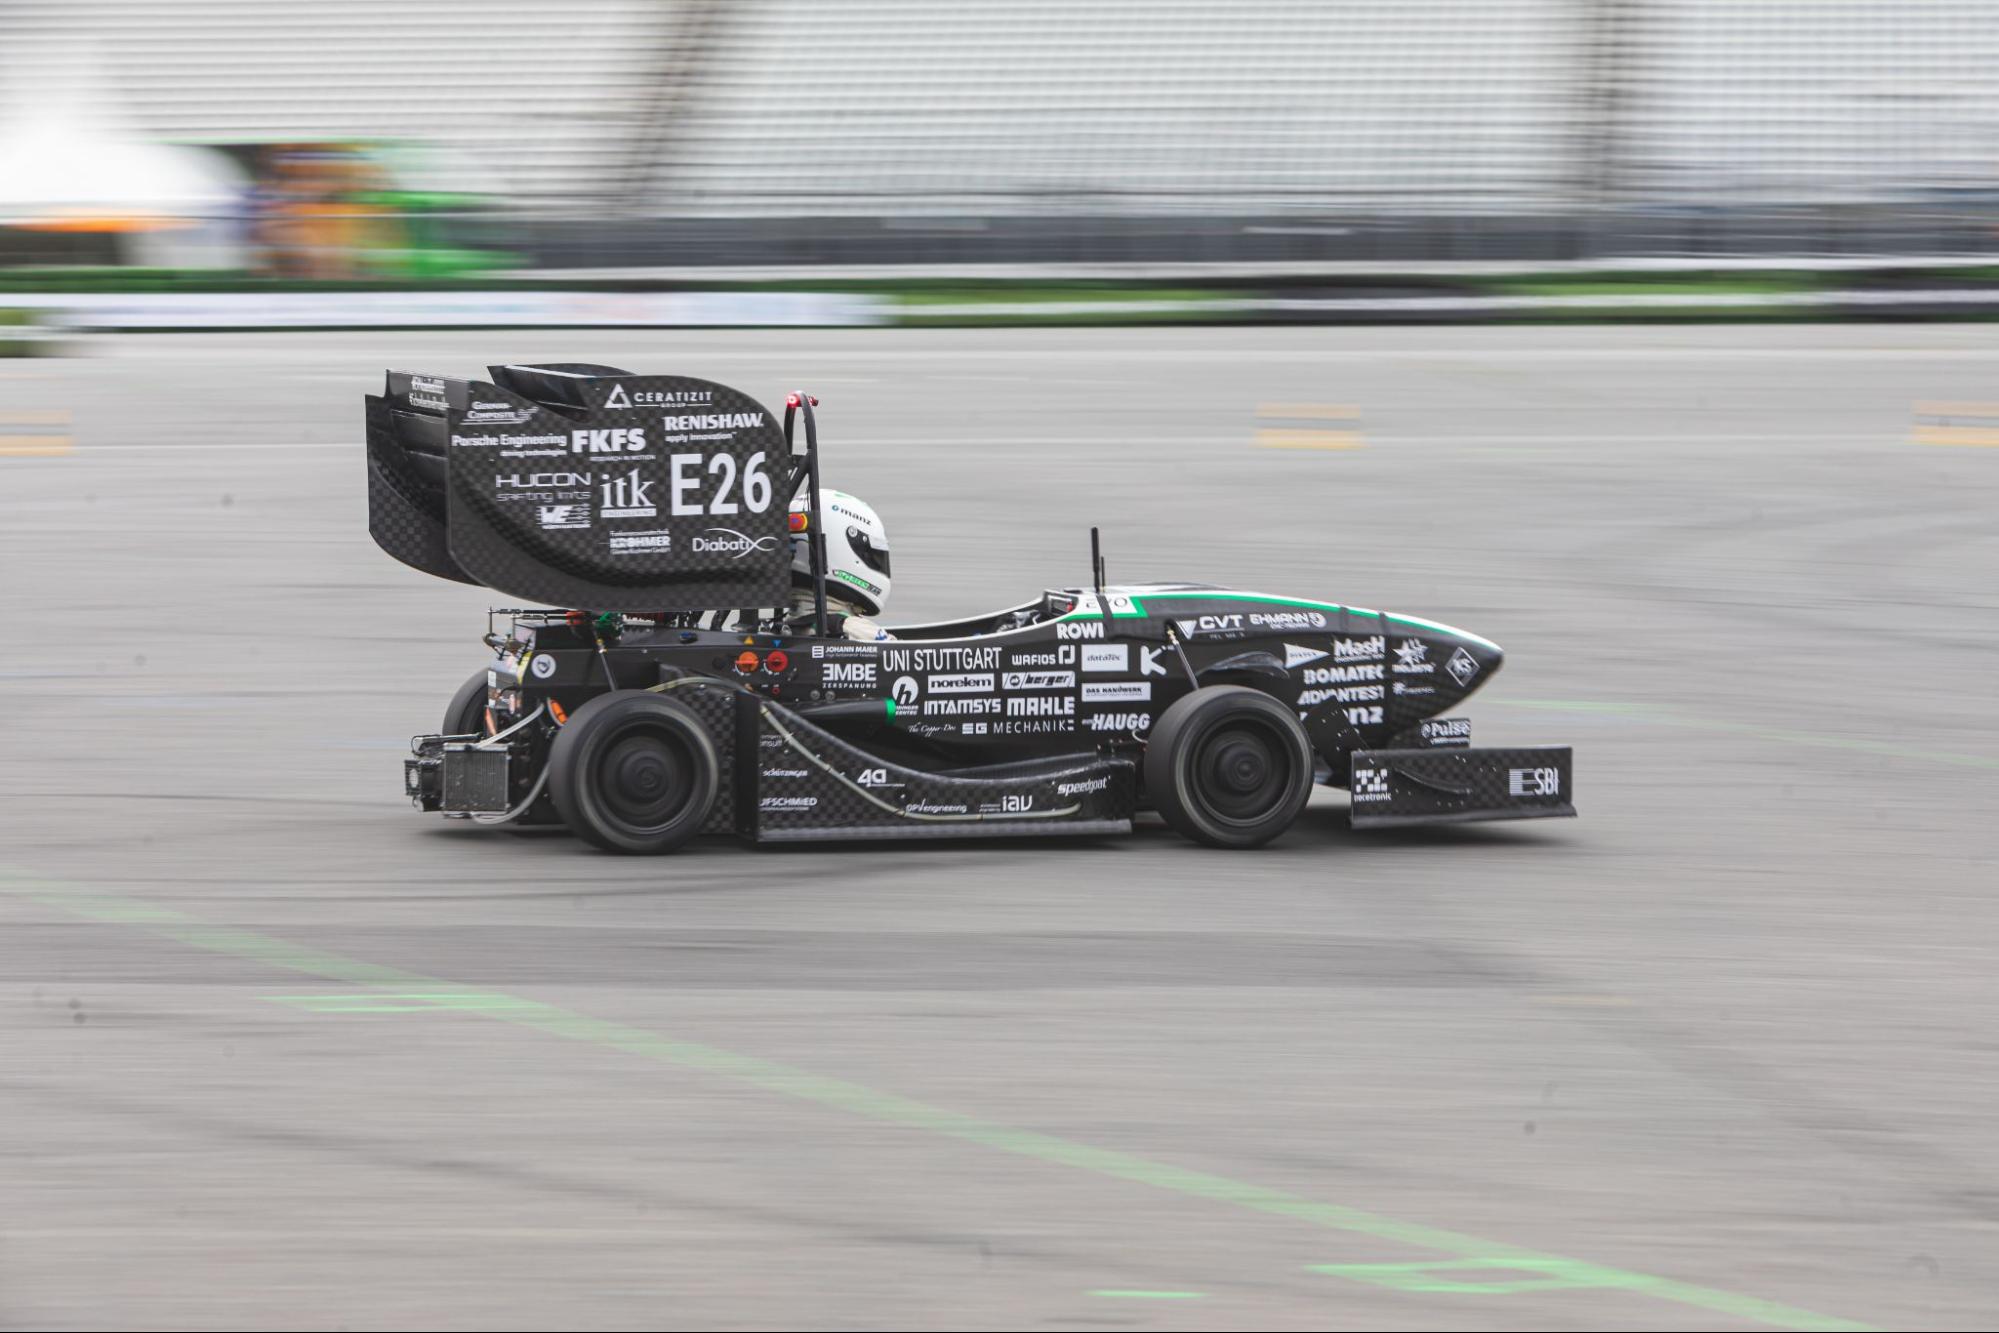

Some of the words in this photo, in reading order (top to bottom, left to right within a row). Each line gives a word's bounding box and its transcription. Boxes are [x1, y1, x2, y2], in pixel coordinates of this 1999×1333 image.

[633, 391, 713, 403] CERATIZIT
[663, 412, 763, 431] RENISHAW
[451, 434, 499, 447] Porsche
[500, 432, 568, 448] Engineering
[571, 428, 646, 453] FKFS
[665, 434, 688, 443] apply
[495, 472, 592, 488] HUCON
[600, 468, 657, 508] itk
[670, 451, 772, 516] E26
[839, 507, 873, 526] manz
[1199, 614, 1243, 630] CVT
[883, 649, 910, 672] UNI
[914, 647, 1002, 671] STUTTGART
[1012, 653, 1056, 666] WAFIOS
[930, 675, 992, 689] norelem
[1025, 673, 1071, 687] berger
[924, 698, 1002, 715] INTAMSYS
[1007, 697, 1075, 716] MAHLE
[1091, 713, 1150, 731] HAUGG
[1057, 778, 1109, 797] speedgoat
[1002, 795, 1033, 812] iav
